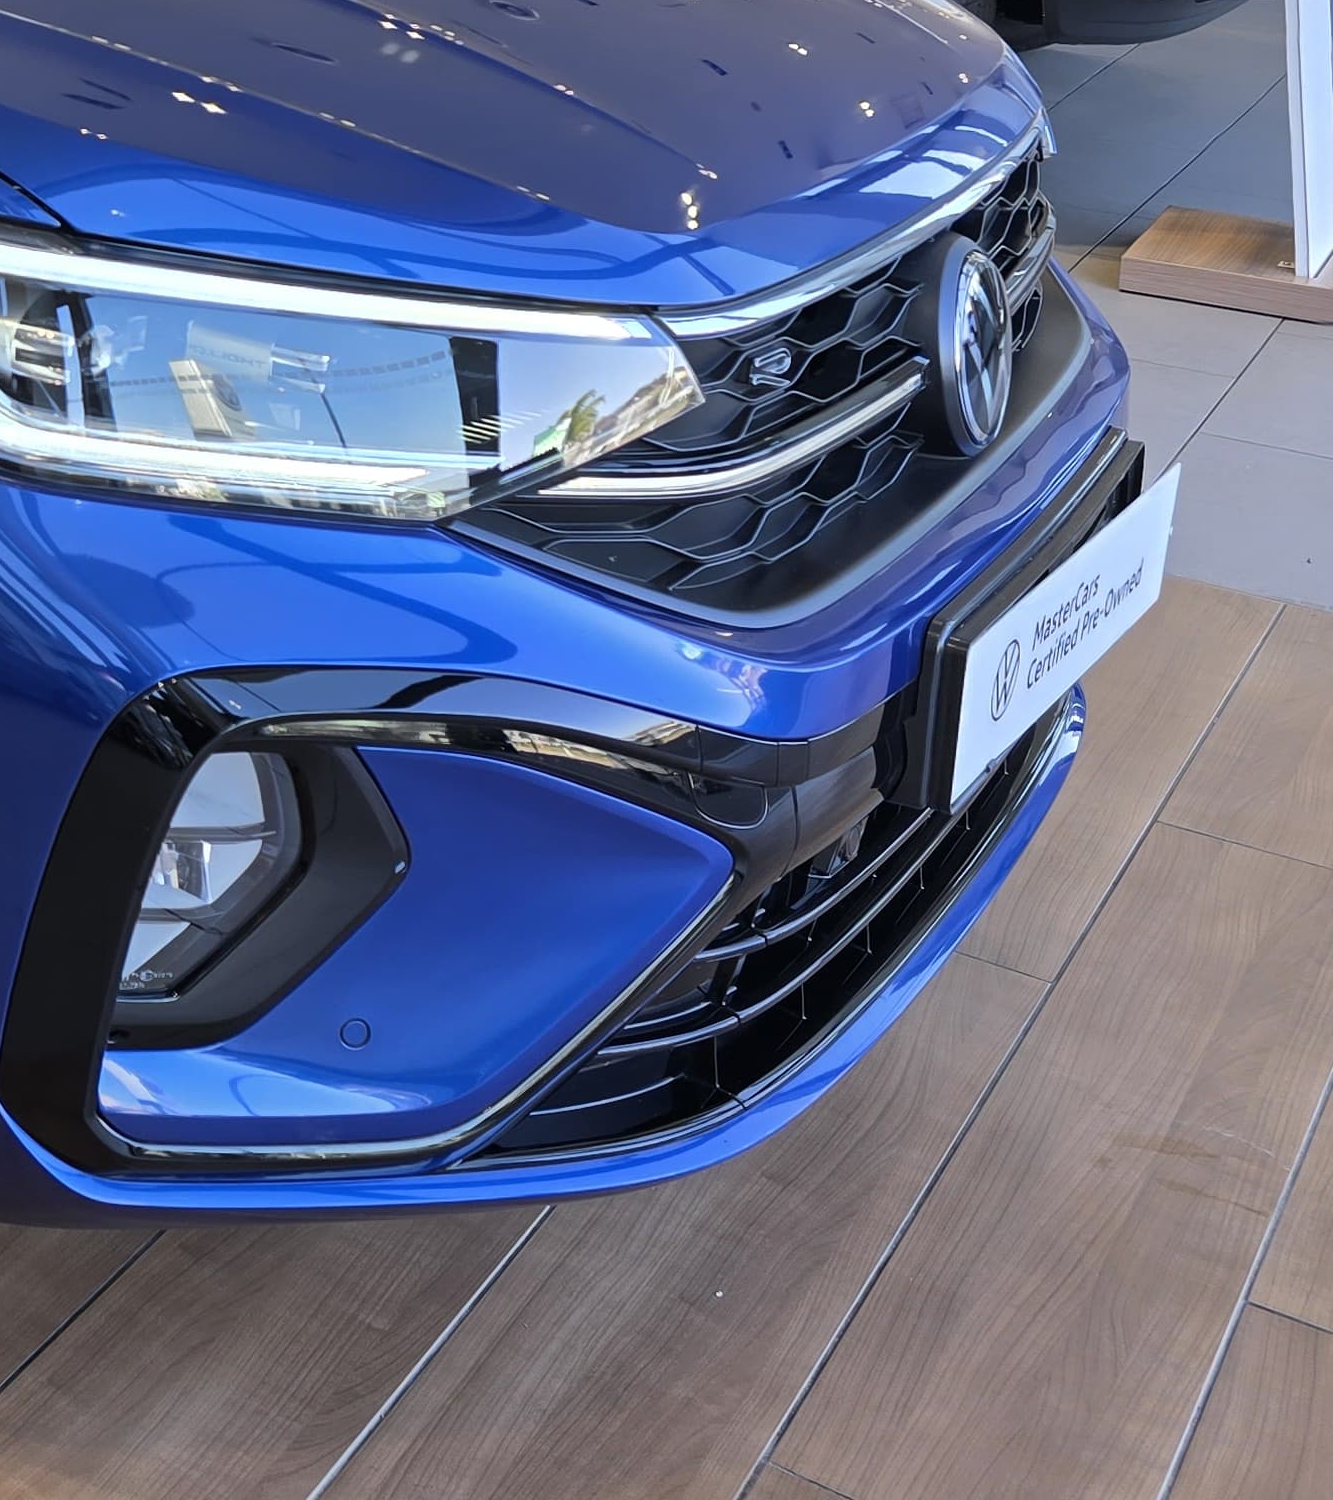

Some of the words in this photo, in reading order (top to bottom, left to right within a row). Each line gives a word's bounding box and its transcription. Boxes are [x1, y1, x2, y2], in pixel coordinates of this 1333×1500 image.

[1026, 619, 1079, 689] Certified
[1082, 557, 1145, 641] Pre-Owned
[1032, 574, 1101, 652] MasterCars
